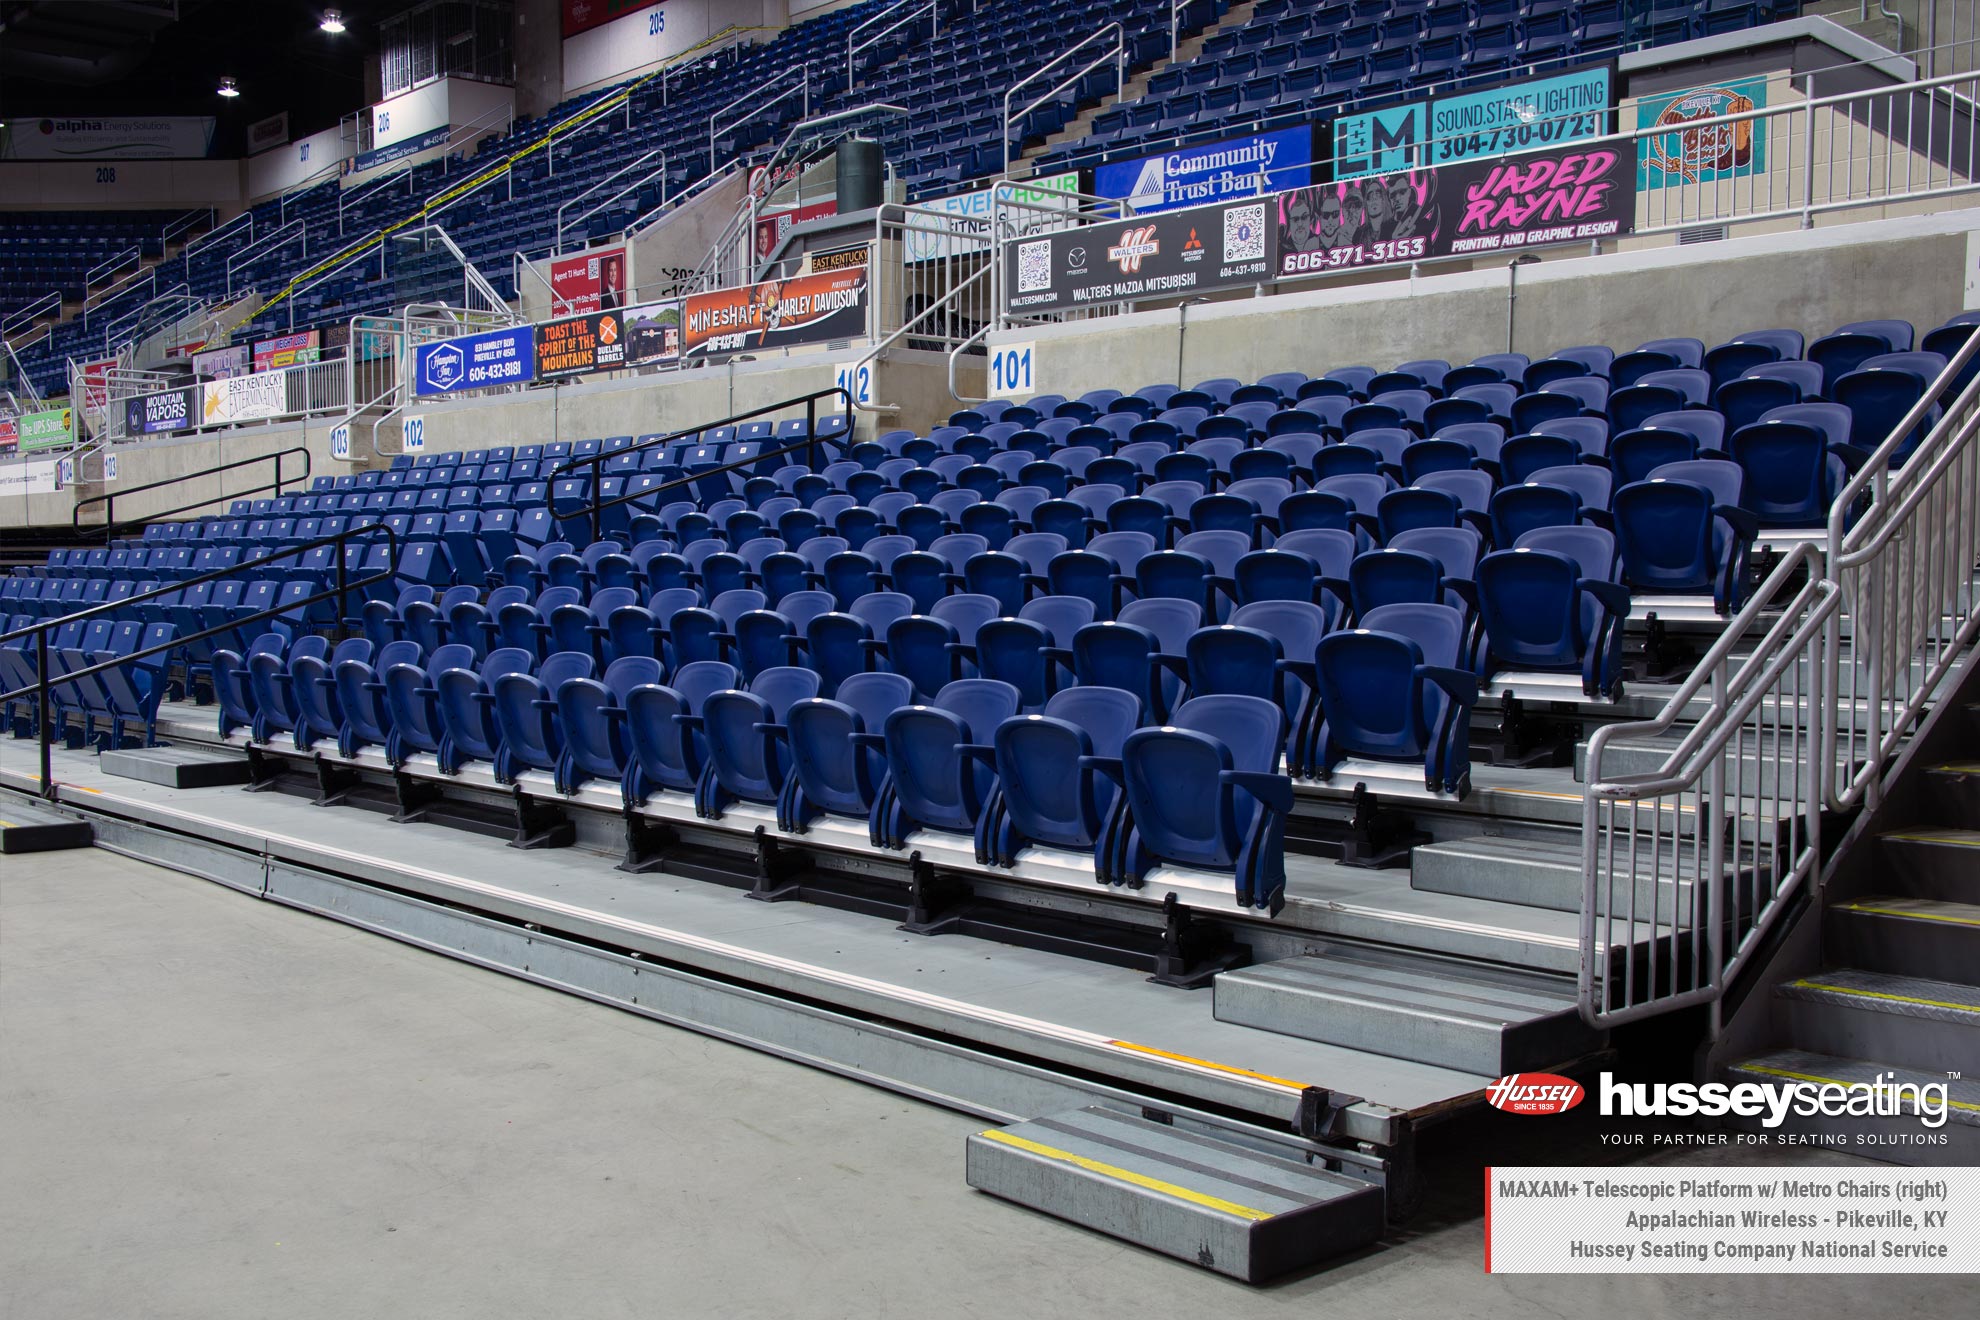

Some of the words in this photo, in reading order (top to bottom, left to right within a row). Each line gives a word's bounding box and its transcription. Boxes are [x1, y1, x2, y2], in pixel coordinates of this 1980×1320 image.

[649, 11, 664, 35] 205
[56, 119, 102, 133] alpha
[104, 121, 132, 131] Energy
[133, 120, 171, 130] Solutions
[378, 111, 390, 133] 206
[300, 143, 310, 162] 207
[1166, 138, 1278, 177] Community
[96, 167, 116, 183] 208
[1166, 174, 1215, 203] Trust
[1220, 163, 1273, 198] Bank
[1468, 150, 1618, 200] JADED
[1458, 183, 1612, 233] RAYNE
[1451, 235, 1500, 252] PRINTING
[1501, 232, 1525, 245] AND
[1527, 226, 1574, 243] GRAPHIC
[1576, 221, 1618, 237] DESIGN
[812, 256, 830, 269] EAST
[830, 249, 868, 266] KENTUCKY
[1113, 244, 1154, 257] WALTERS
[1181, 249, 1205, 258] MITSUBISHI
[1184, 254, 1202, 262] MOTORS
[1283, 236, 1424, 272] 606-371-3153
[553, 271, 568, 282] Agent
[573, 268, 586, 277] Hurst
[1066, 267, 1088, 277] mazda
[1219, 262, 1266, 278] 606-437-9810
[1073, 284, 1112, 302] WALTERS
[1113, 280, 1144, 297] MAZDA
[1145, 272, 1196, 293] MITSUBISHI
[1010, 292, 1058, 307] WALTERSMM.COM
[689, 302, 766, 334] MINESHAFT
[778, 295, 812, 318] HARLEY
[814, 287, 859, 313] DAVIDSON
[544, 322, 570, 340] TOAST
[571, 319, 589, 336] THE
[276, 337, 293, 349] WEIGHT
[294, 335, 307, 347] LOSS
[503, 337, 515, 348] BLVD
[538, 339, 567, 357] SPIRIT
[567, 337, 577, 349] OF
[577, 335, 596, 350] THE
[597, 344, 623, 356] DUELING
[430, 353, 460, 370] Hampton
[496, 349, 503, 359] KY
[542, 350, 594, 371] MOUNTAINS
[597, 352, 624, 364] BARRELS
[437, 365, 453, 378] Inn
[469, 360, 521, 382] 606-432-8181
[992, 348, 1031, 391] 101
[229, 379, 246, 392] EAST
[246, 373, 283, 389] KENTUCKY
[146, 392, 184, 408] MOUNTAIN
[229, 385, 284, 417] EXTERMINATING
[146, 402, 187, 422] VAPORS
[21, 423, 33, 437] The
[33, 420, 46, 435] UPS
[46, 418, 63, 433] Store
[404, 419, 424, 447] 102
[332, 428, 348, 454] 103
[62, 461, 73, 481] 104
[105, 456, 116, 477] 103
